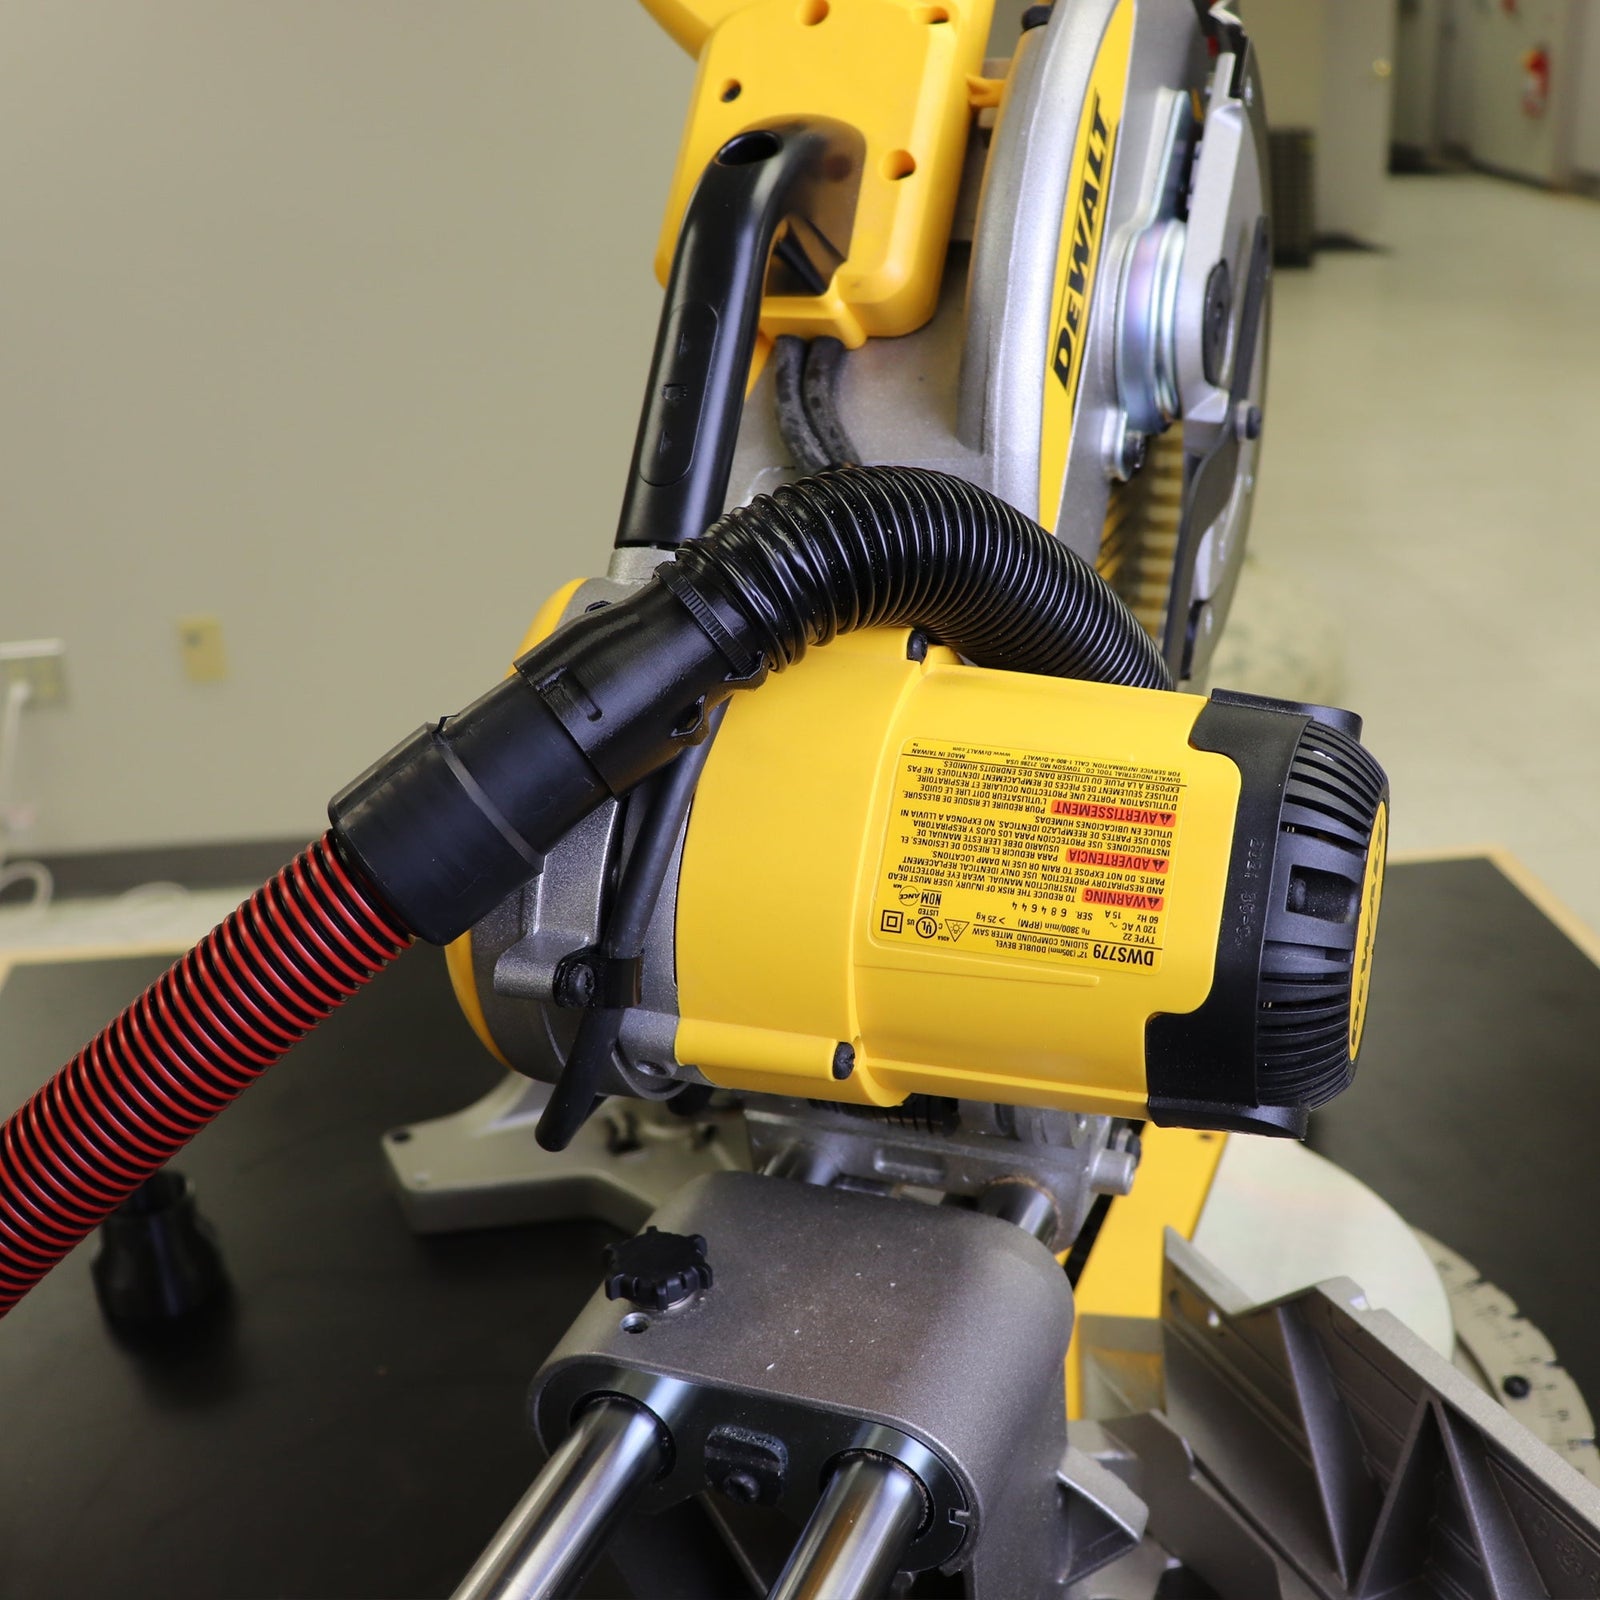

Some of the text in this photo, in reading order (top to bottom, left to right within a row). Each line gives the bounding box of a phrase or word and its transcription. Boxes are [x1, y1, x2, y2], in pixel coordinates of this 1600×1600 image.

[1051, 87, 1110, 395] DEWALT
[907, 764, 921, 772] PAS
[923, 766, 933, 774] NE
[979, 764, 1016, 774] ENDROITS
[1017, 768, 1032, 776] DES
[1034, 770, 1055, 779] DANS
[1056, 773, 1089, 783] UTILISER
[1114, 771, 1152, 779] INDUSTRIAL
[981, 773, 1041, 786] REMPLACEMENT
[1104, 778, 1124, 787] PLUIE
[982, 781, 1018, 792] OCULAIRE
[1082, 784, 1096, 792] DES
[1145, 783, 1179, 793] EXPOSER
[920, 783, 1046, 805] L'UTILISATEUR DOIT LIRE LE GUIDE
[1020, 786, 1067, 798] PROTECTION
[1069, 791, 1085, 800] UNE
[1098, 786, 1142, 797] SEULEMENT
[1144, 791, 1177, 801] UTILISEZ
[953, 796, 980, 806] RISQUE
[982, 799, 989, 807] LE
[1087, 794, 1115, 803] PORTEZ
[1024, 804, 1045, 813] POUR
[1054, 801, 1157, 824] AVERTISSEMENT
[910, 810, 936, 819] LLUVIA
[945, 814, 981, 825] EXPONGA
[1041, 825, 1087, 837] REEMPLAZO
[1075, 820, 1128, 833] UBICACIONES
[928, 830, 961, 840] MANUAL
[975, 827, 995, 836] OJOS
[997, 829, 1012, 837] LOS
[1014, 831, 1035, 840] PARA
[1089, 831, 1099, 839] DE
[1143, 828, 1172, 838] UTILICE
[900, 835, 908, 843] EL
[963, 834, 981, 843] ESTE
[983, 836, 1001, 845] LEER
[1036, 834, 1085, 847] PROTECCIÓN
[1101, 832, 1131, 842] PARTES
[1133, 836, 1148, 845] USE
[962, 843, 989, 853] RIESGO
[1003, 839, 1022, 848] DEBE
[1024, 841, 1059, 852] USUARIO
[1087, 840, 1102, 848] USE
[991, 846, 1000, 854] EL
[1001, 848, 1035, 858] REDUCIR
[976, 856, 999, 865] DAMP
[1036, 852, 1057, 861] PARA
[1068, 849, 1149, 870] ADVERTENCIA
[902, 855, 957, 869] REPLACEMENT
[1012, 860, 1027, 868] USE
[1028, 862, 1039, 870] OR
[897, 864, 944, 876] PROTECTION
[959, 862, 998, 874] IDENTICAL
[1000, 868, 1020, 877] ONLY
[1041, 864, 1060, 873] RAIN
[1062, 866, 1072, 874] TO
[887, 872, 907, 881] READ
[946, 870, 960, 878] EYE
[962, 872, 985, 881] WEAR
[1022, 870, 1037, 879] USE
[1074, 868, 1104, 878] EXPOSE
[1106, 872, 1122, 880] NOT
[909, 874, 931, 884] MUST
[933, 877, 952, 886] USER
[1124, 874, 1135, 882] DO
[985, 884, 995, 892] OF
[997, 885, 1014, 894] RISK
[1024, 880, 1076, 893] INSTRUCTION
[1091, 879, 1144, 892] RESPIRATORY
[1146, 886, 1163, 894] AND
[899, 890, 919, 901] ANCE
[1016, 888, 1031, 896] THE
[1033, 890, 1063, 900] REDUCE
[920, 892, 941, 905] NOM
[1065, 894, 1075, 902] TO
[1084, 889, 1146, 907] WARNING
[917, 908, 938, 916] LISTED
[975, 912, 996, 923] 25 kg
[1104, 910, 1158, 924] 60 Hz 15 A
[1017, 918, 1079, 934] 3800/min (RPM)
[1121, 922, 1156, 934] 120 V AC
[972, 927, 1088, 949] SLIDING COMPOUND MITER SAW
[1122, 932, 1155, 944] TYPE 22
[994, 939, 1016, 949] BEVEL
[1018, 942, 1046, 953] DOUBLE
[1092, 943, 1153, 966] DWS779
